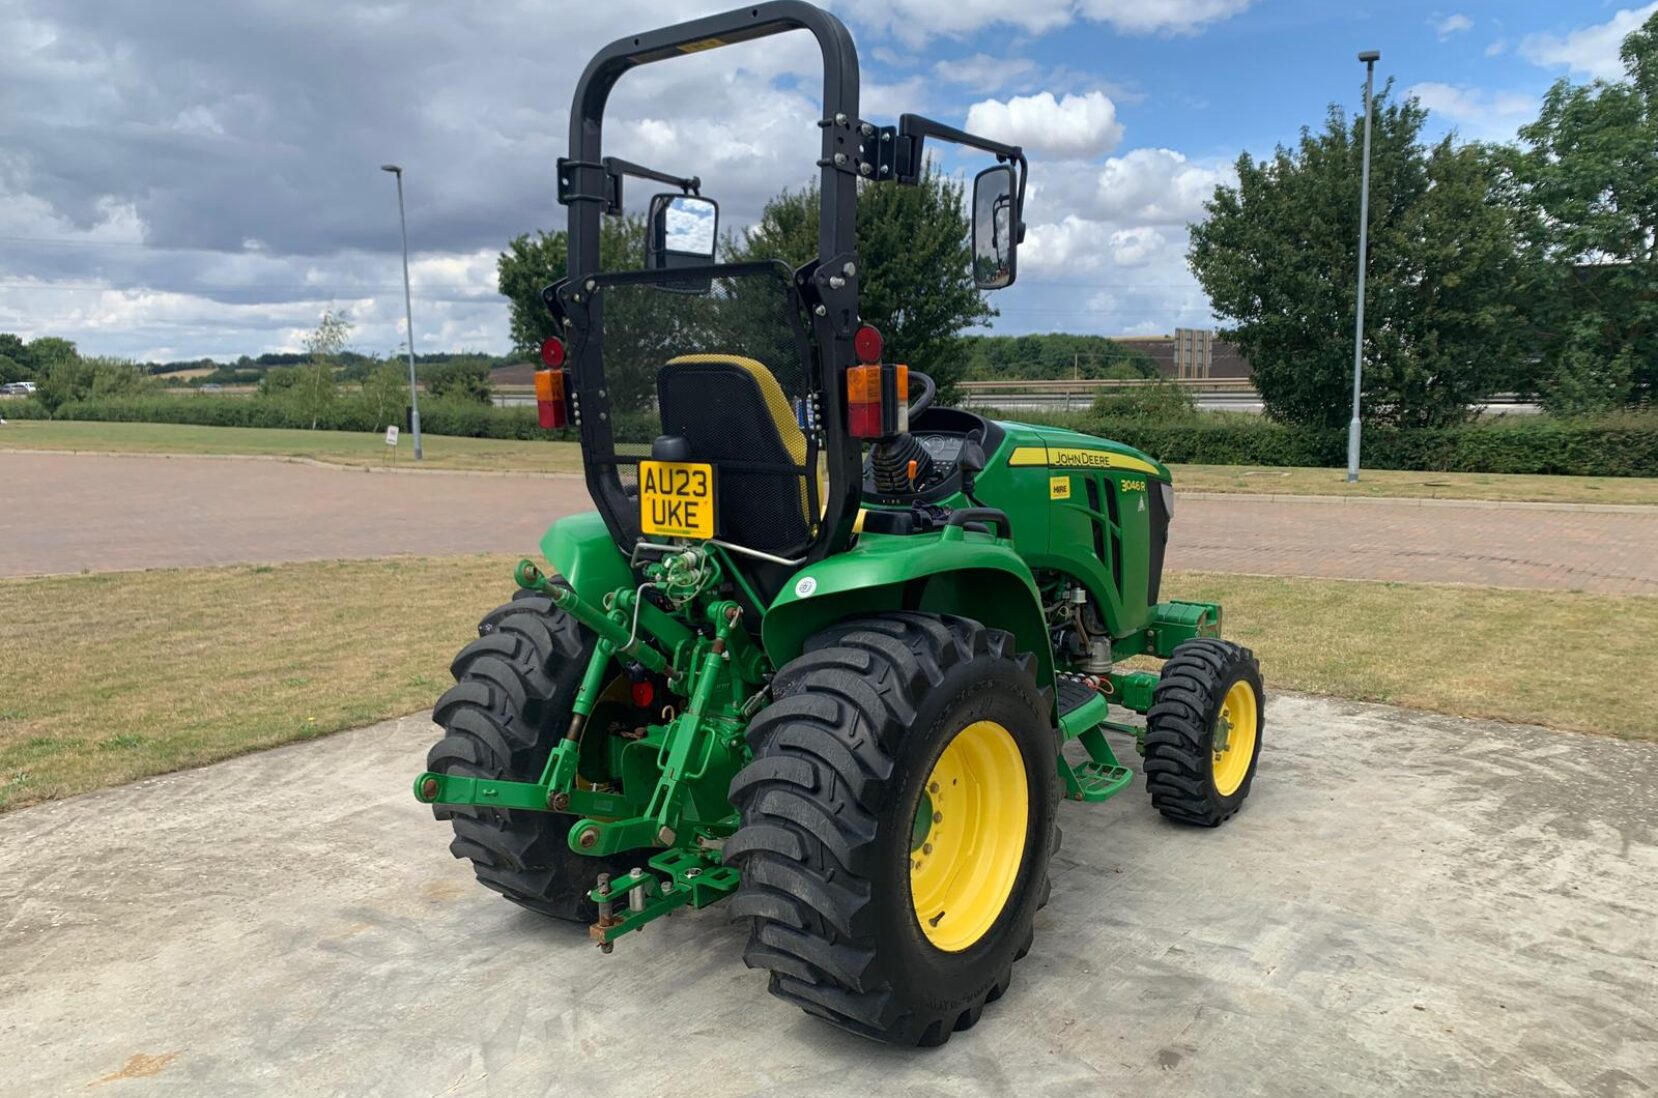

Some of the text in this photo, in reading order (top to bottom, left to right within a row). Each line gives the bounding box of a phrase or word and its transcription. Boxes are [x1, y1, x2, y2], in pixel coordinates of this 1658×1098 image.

[1056, 451, 1110, 465] JOHN DEERE
[644, 467, 708, 497] AU23
[1053, 485, 1067, 494] HIRE
[652, 498, 700, 529] UKE
